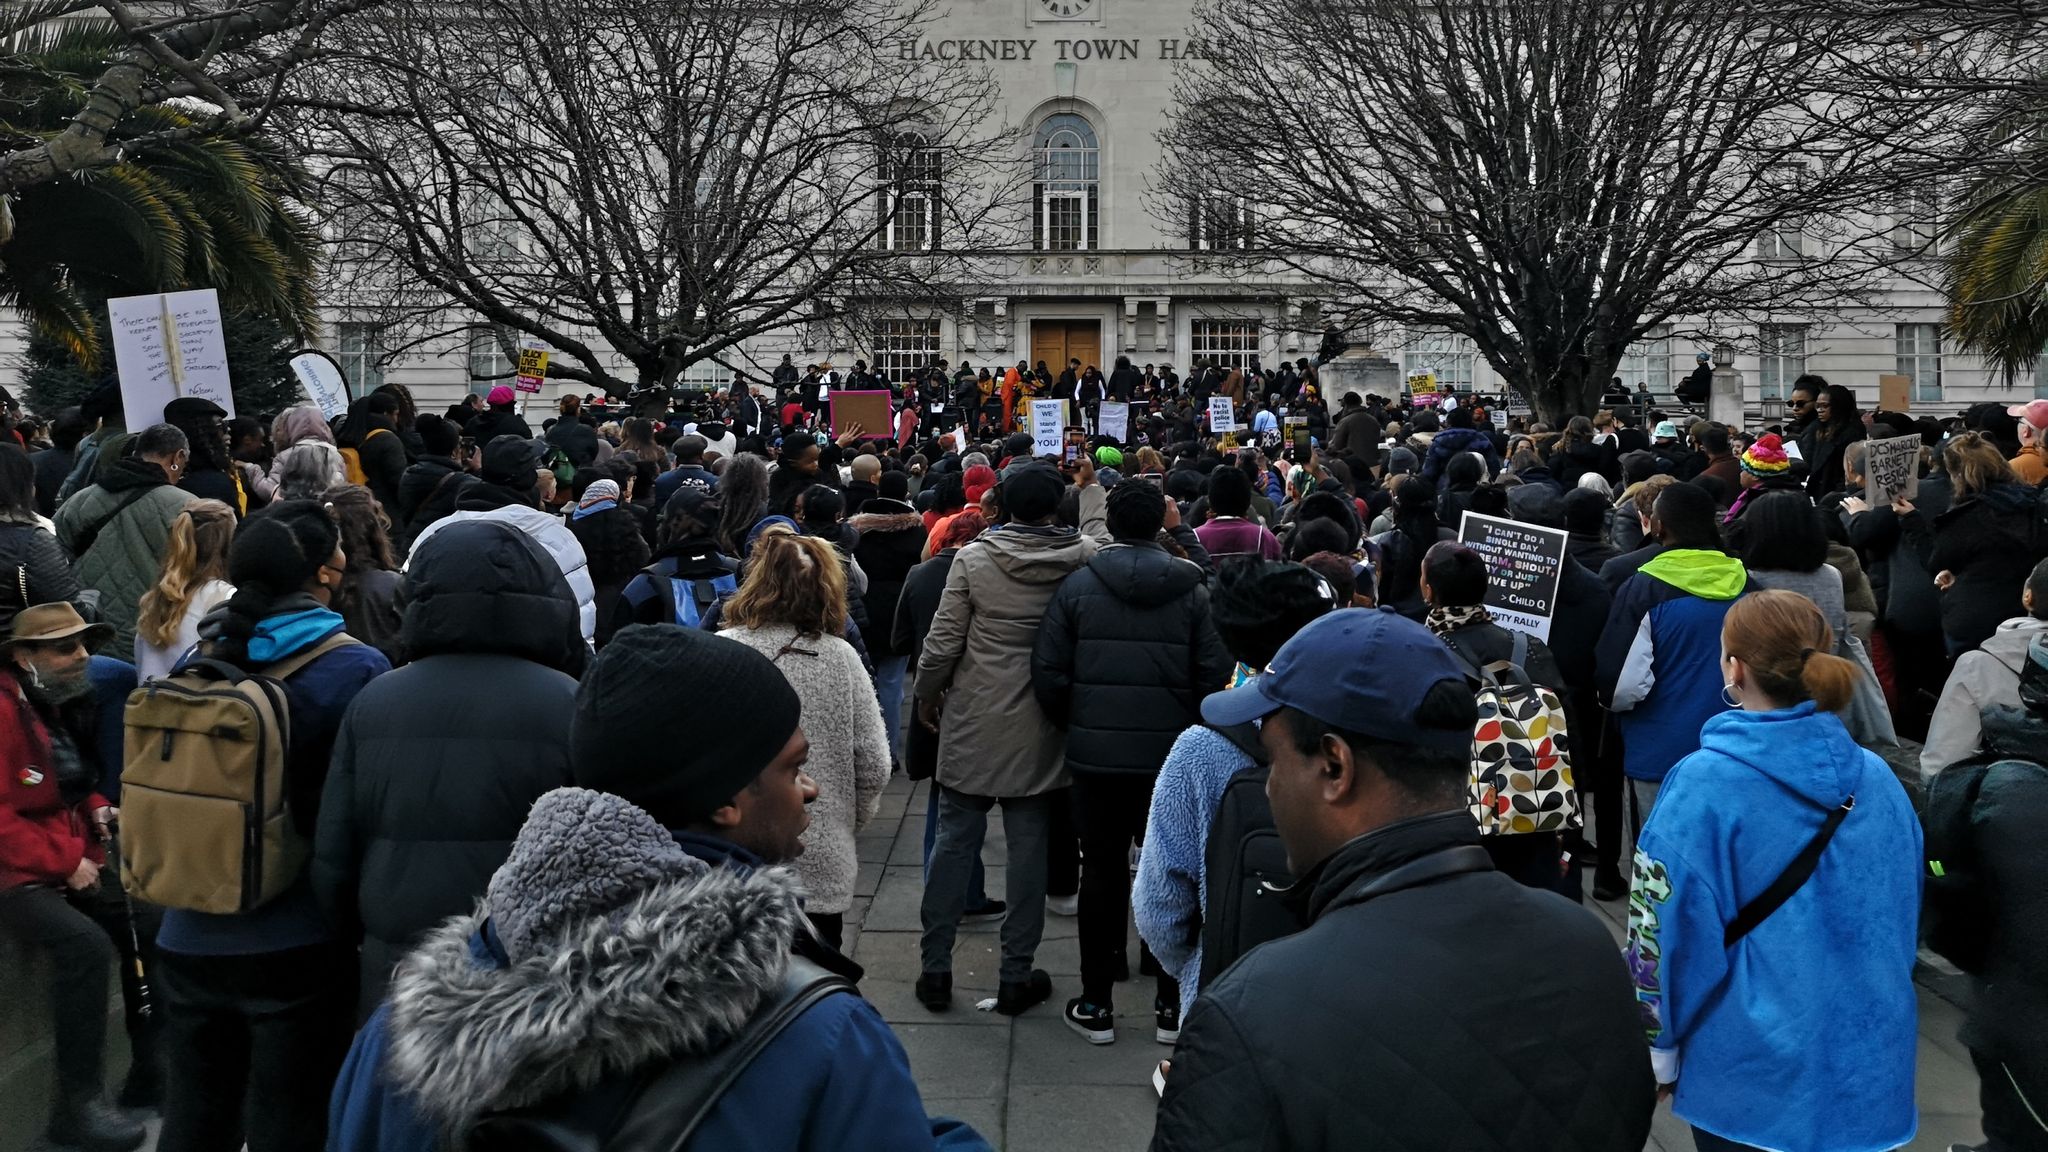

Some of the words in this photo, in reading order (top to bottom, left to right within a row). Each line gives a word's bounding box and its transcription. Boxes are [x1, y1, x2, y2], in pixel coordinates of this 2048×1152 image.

[899, 39, 1037, 61] HACKNEY
[1054, 39, 1140, 60] TOWN
[521, 357, 538, 368] LIVES
[522, 349, 543, 360] BLACK
[519, 365, 545, 377] MATTER
[1037, 439, 1059, 447] YOU!
[1870, 450, 1918, 474] BARNETT
[1875, 463, 1911, 489] RESIGN
[1485, 535, 1518, 548] SINGLE
[1520, 542, 1539, 553] DAY
[1494, 528, 1523, 540] CAN'T
[1539, 537, 1545, 545] A
[1464, 540, 1502, 554] WITHOUT
[1504, 548, 1544, 563] WANTING
[1546, 556, 1558, 566] TO
[1479, 552, 1512, 569] REAM,
[1515, 560, 1555, 578] SHOUT,
[1485, 563, 1498, 574] RY
[1501, 568, 1513, 578] OR
[1515, 571, 1540, 583] JUST
[1487, 575, 1507, 587] IVE
[1536, 599, 1546, 611] Q
[1513, 614, 1541, 629] RALLY
